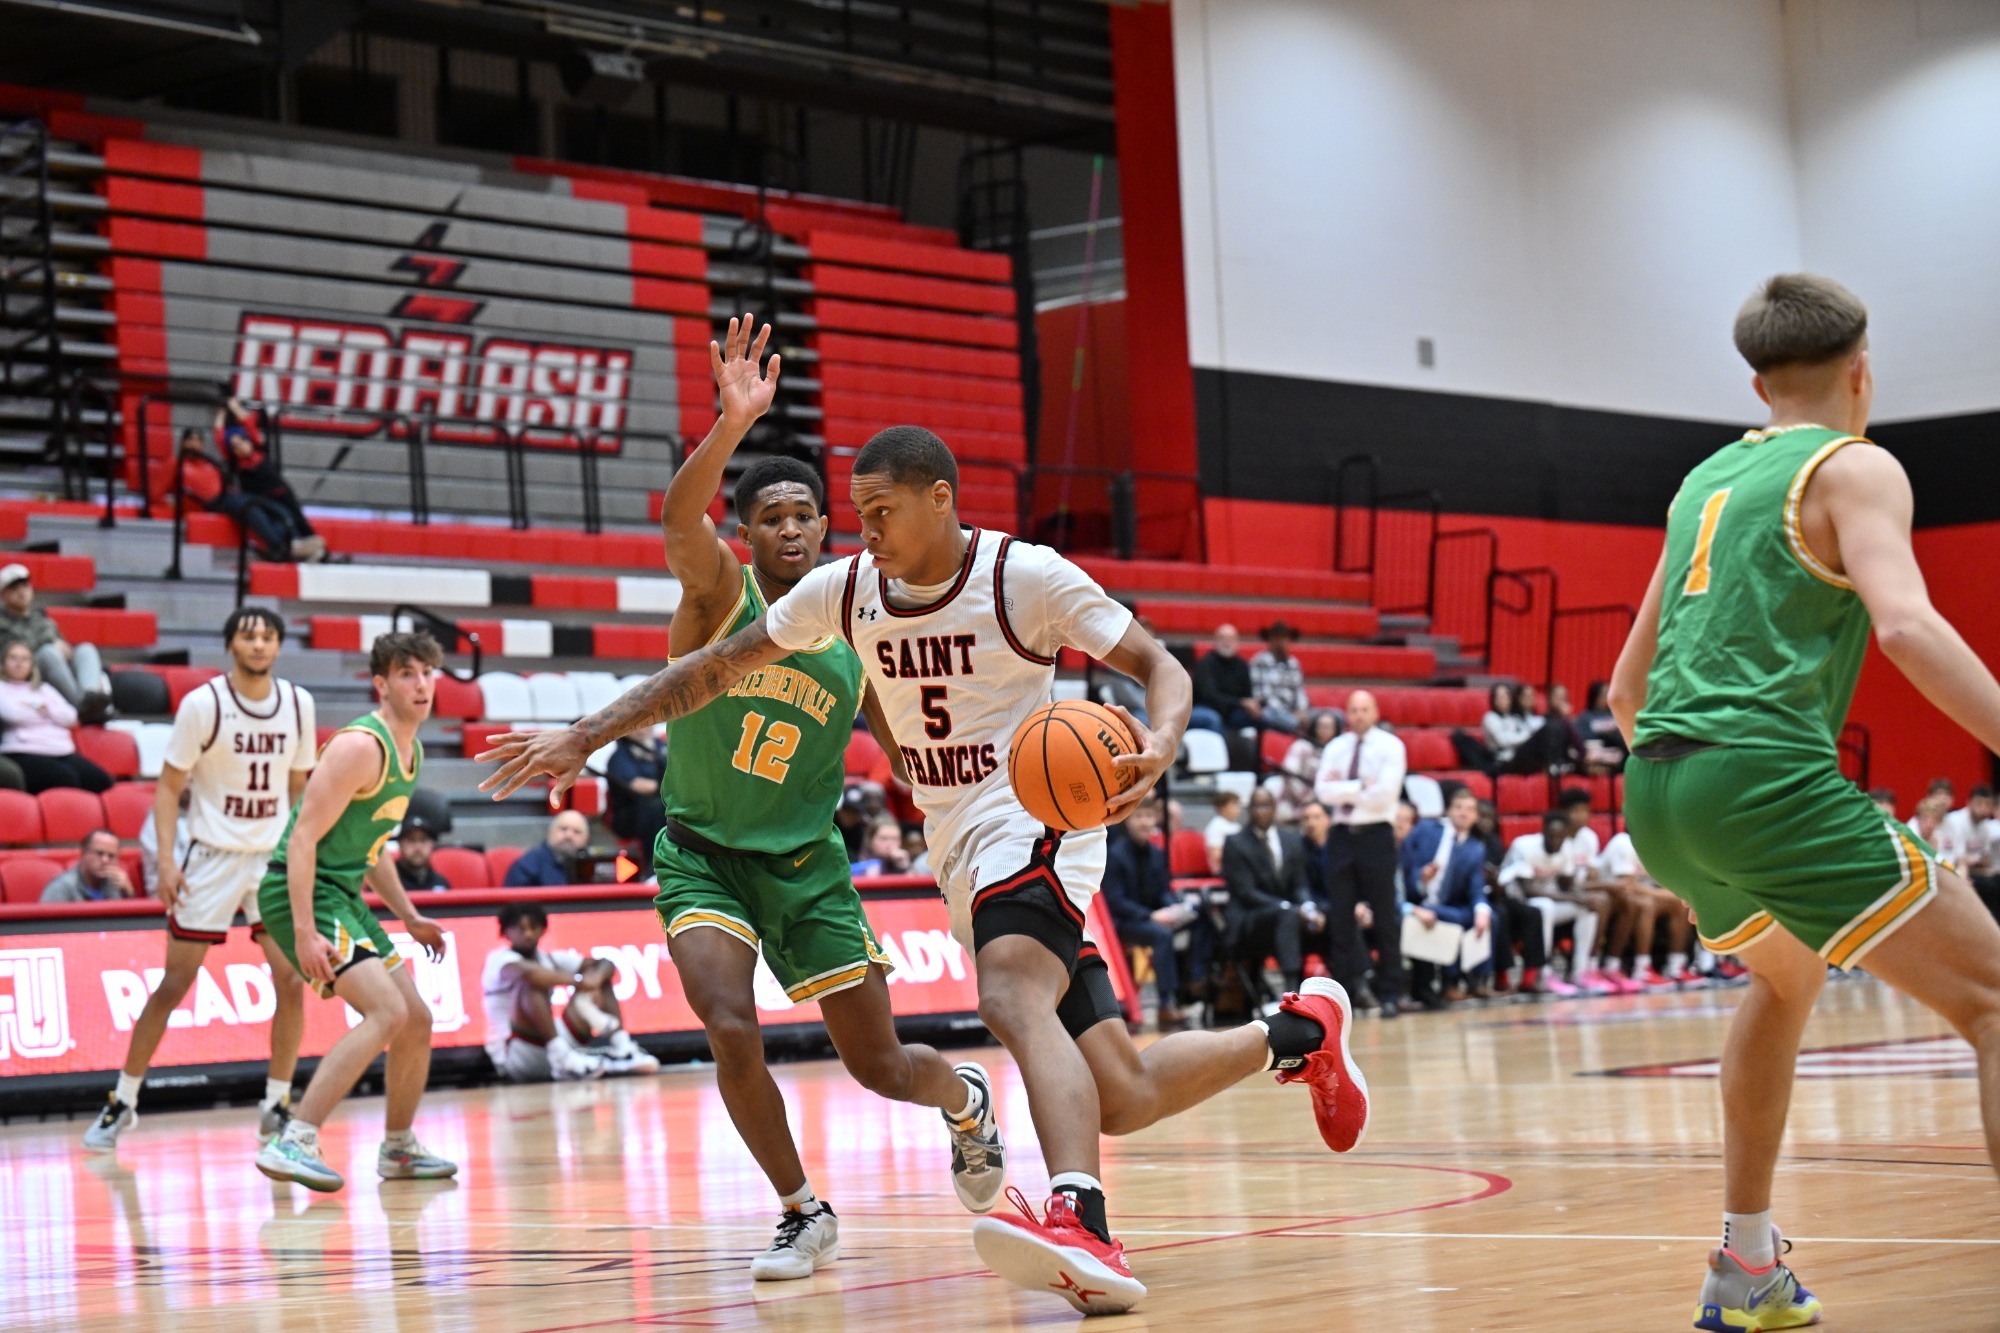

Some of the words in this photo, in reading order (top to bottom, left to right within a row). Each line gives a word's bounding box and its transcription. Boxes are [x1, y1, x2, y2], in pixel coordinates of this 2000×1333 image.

[233, 312, 393, 436] RED
[388, 329, 633, 454] FLASH
[1682, 486, 1733, 596] 1
[876, 634, 976, 679] SAINT
[920, 685, 952, 740] 5
[234, 733, 287, 755] SAINT
[731, 710, 802, 785] 12
[900, 743, 999, 787] FRANCIS
[247, 762, 270, 791] 11
